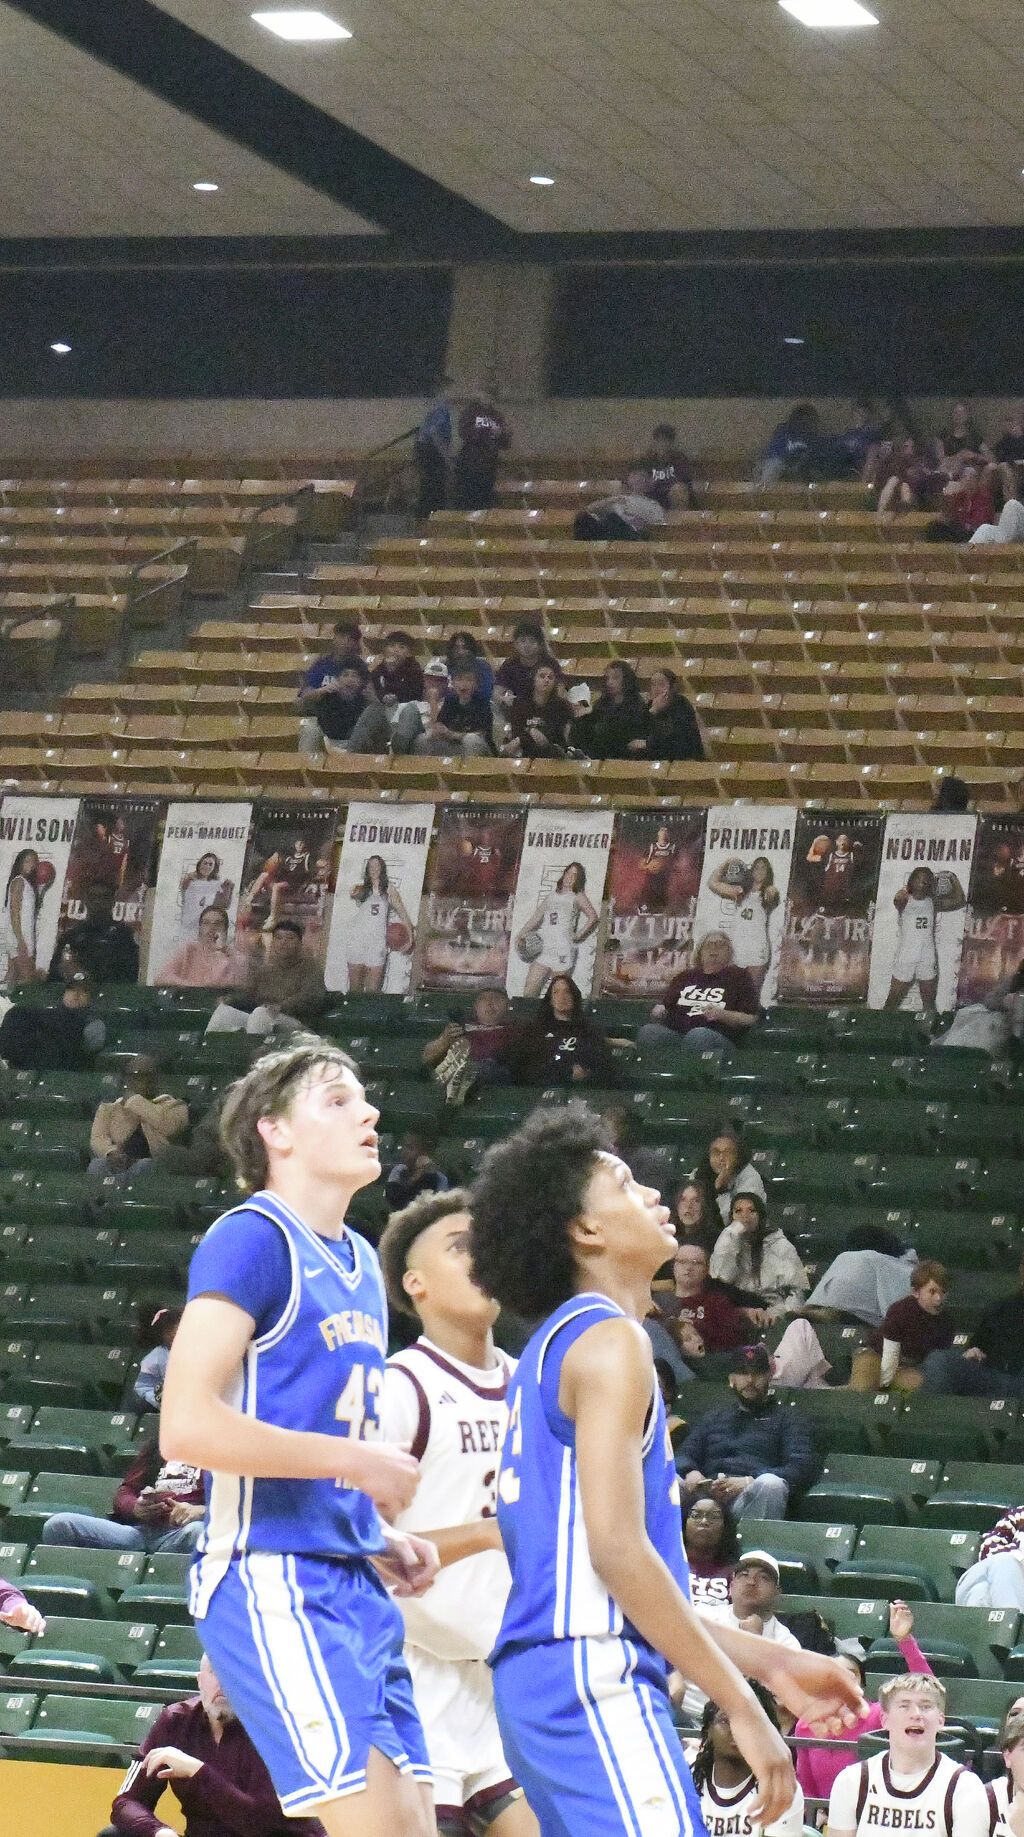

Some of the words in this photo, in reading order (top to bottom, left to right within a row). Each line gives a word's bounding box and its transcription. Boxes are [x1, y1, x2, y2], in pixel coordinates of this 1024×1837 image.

[0, 817, 75, 843] WILSON
[350, 824, 428, 845] ERDWURM
[527, 832, 610, 849] VANDERVEER
[709, 828, 791, 850] PRIMERA
[886, 838, 972, 862] NORMAN
[915, 917, 928, 929] 22
[335, 1363, 385, 1442] 43
[827, 1528, 840, 1538] 24
[953, 1534, 965, 1544] 25
[689, 1573, 728, 1599] HS
[860, 1603, 873, 1613] 25
[990, 1611, 1003, 1621] 26
[703, 1813, 754, 1837] EBELS
[868, 1804, 937, 1831] REBELS
